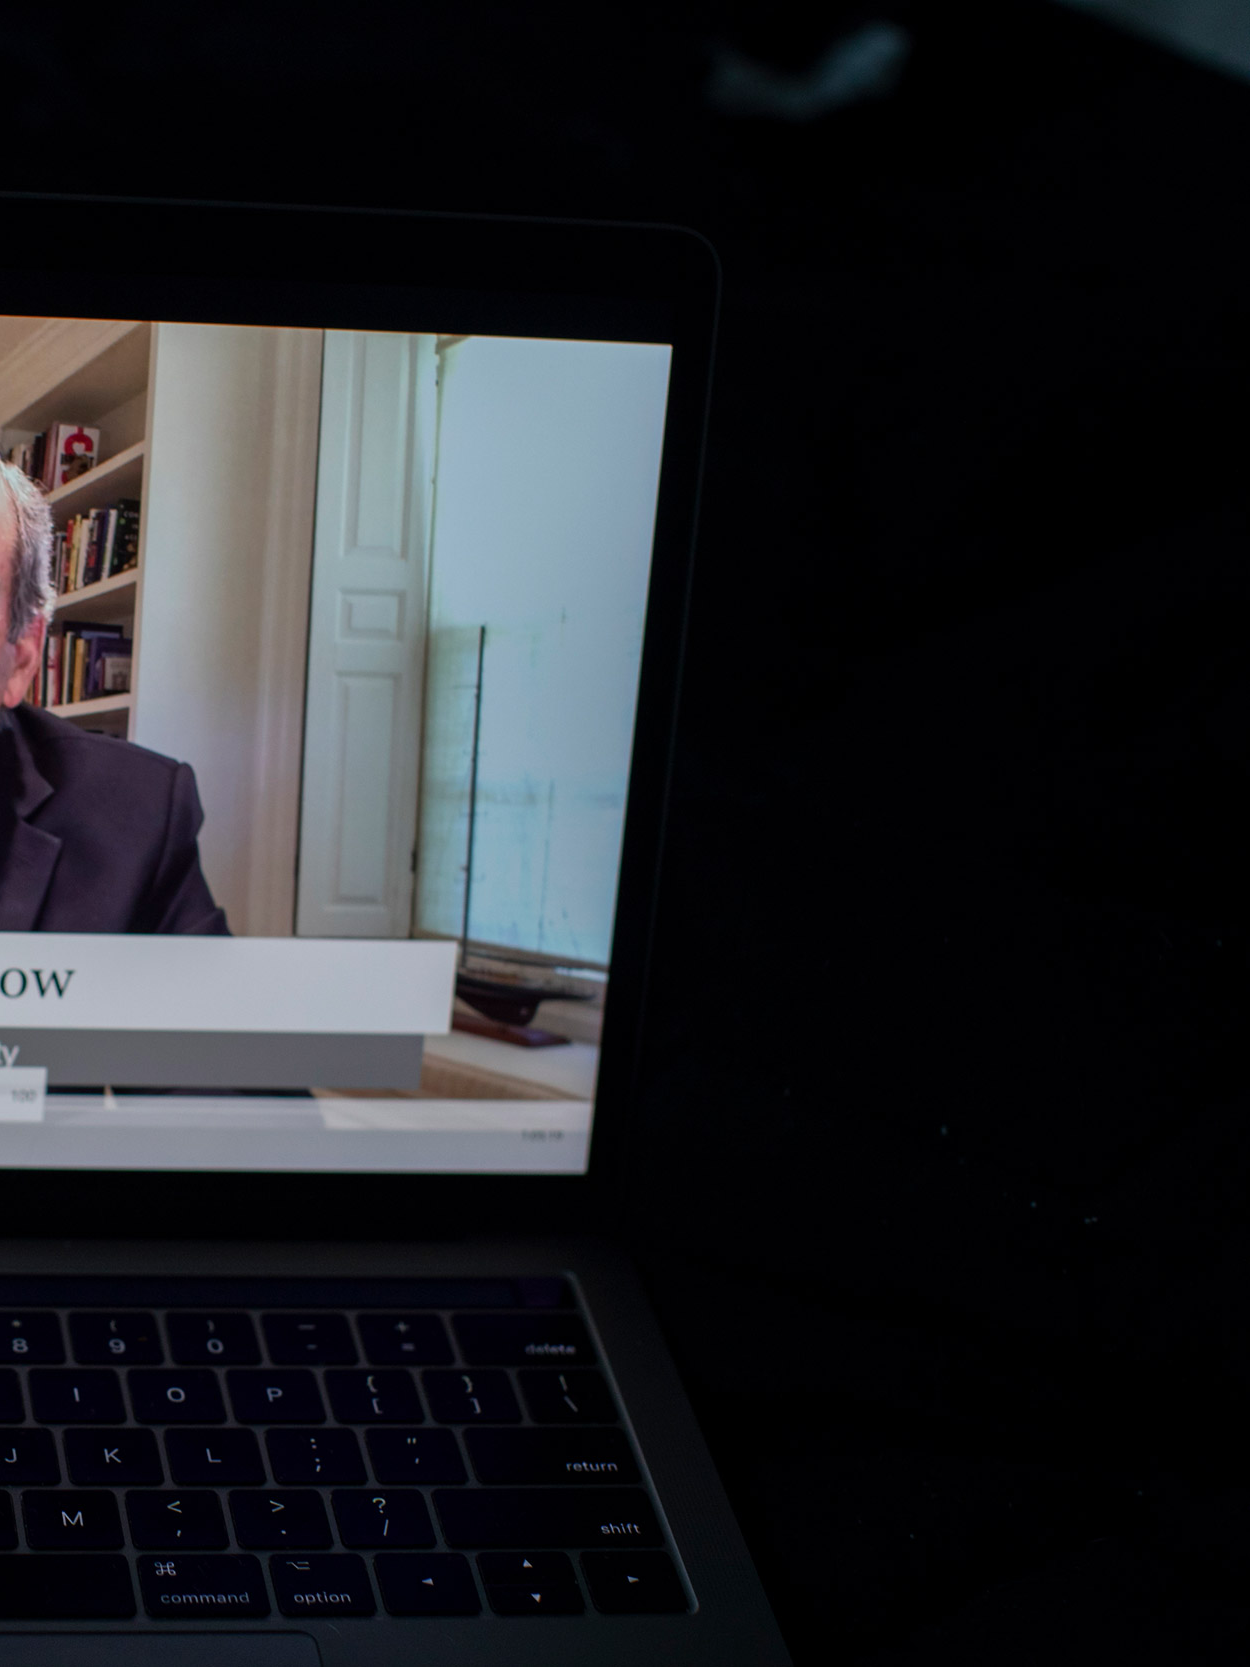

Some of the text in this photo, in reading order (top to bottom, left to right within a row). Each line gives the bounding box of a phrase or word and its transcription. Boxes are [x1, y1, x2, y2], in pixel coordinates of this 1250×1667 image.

[12, 1337, 29, 1353] 8
[108, 1338, 126, 1354] 9
[206, 1338, 224, 1354] 0
[524, 1343, 575, 1354] delete
[166, 1386, 186, 1403] O
[266, 1387, 283, 1402] P
[4, 1447, 17, 1463] J
[103, 1447, 122, 1463] K
[205, 1447, 222, 1463] L
[565, 1461, 618, 1471] return
[166, 1500, 182, 1514] <
[269, 1499, 285, 1513] >
[372, 1496, 386, 1514] ?
[61, 1510, 84, 1527] M
[600, 1522, 639, 1534] shift
[160, 1591, 250, 1603] command
[293, 1591, 351, 1605] option
